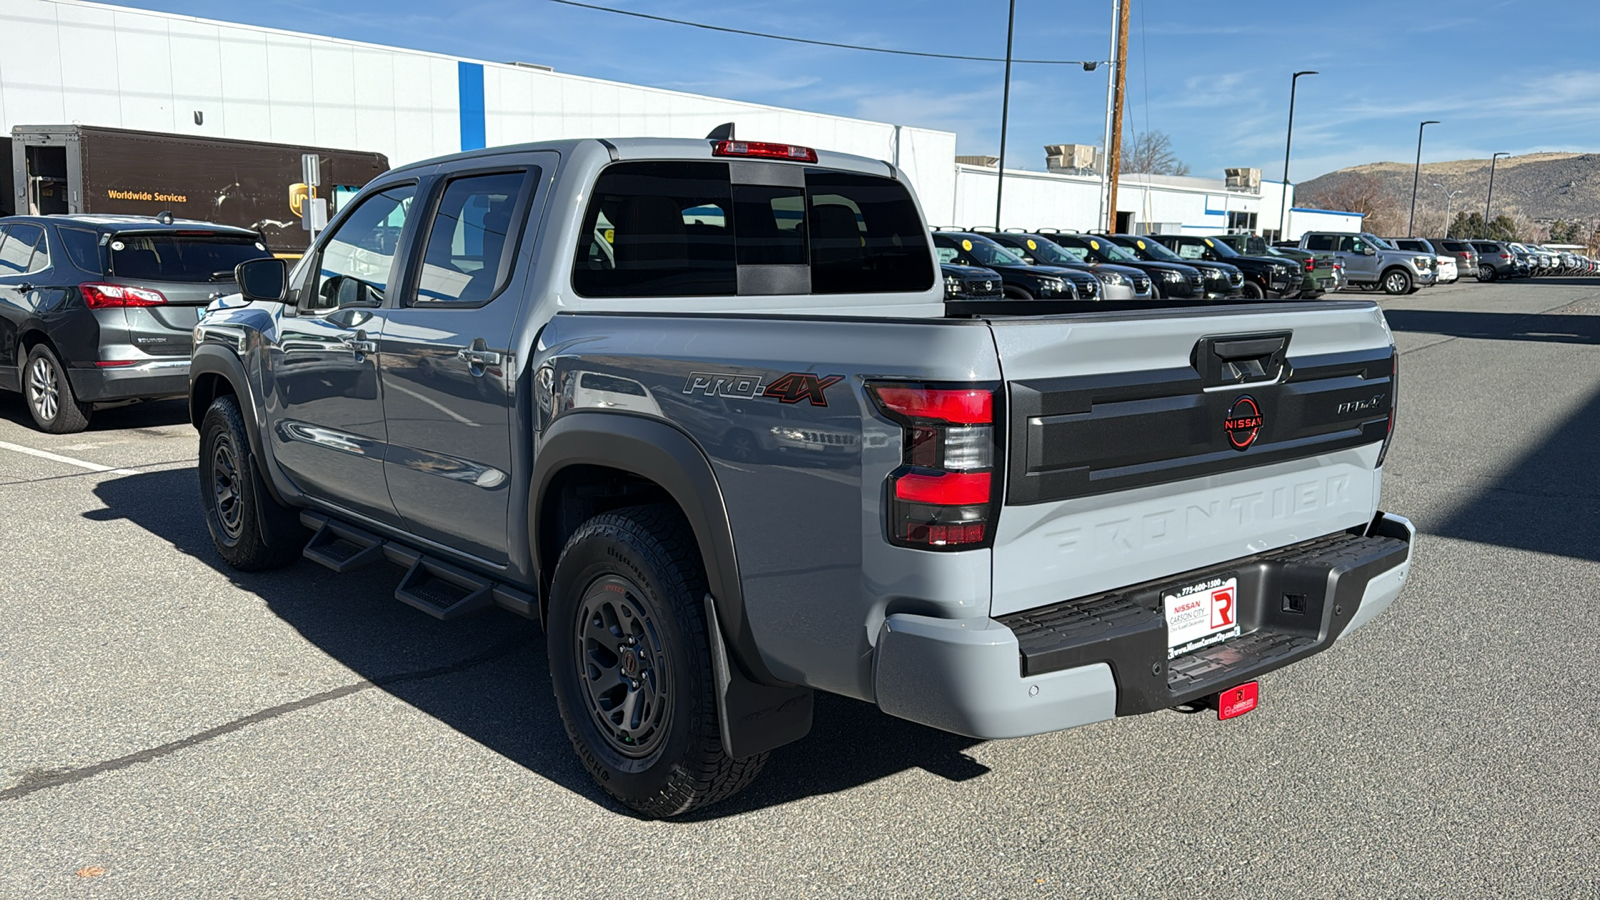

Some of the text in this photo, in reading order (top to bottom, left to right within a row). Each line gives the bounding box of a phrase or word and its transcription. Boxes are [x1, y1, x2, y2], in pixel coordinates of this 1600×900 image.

[107, 189, 187, 203] Worldwide Services
[682, 371, 847, 408] PRO-4X
[1224, 416, 1262, 430] NISSAN
[1043, 473, 1350, 566] FRONTIER
[1181, 578, 1221, 596] 775-600-1500
[1169, 607, 1205, 625] CARSON CITY
[1174, 600, 1201, 614] NISSAN
